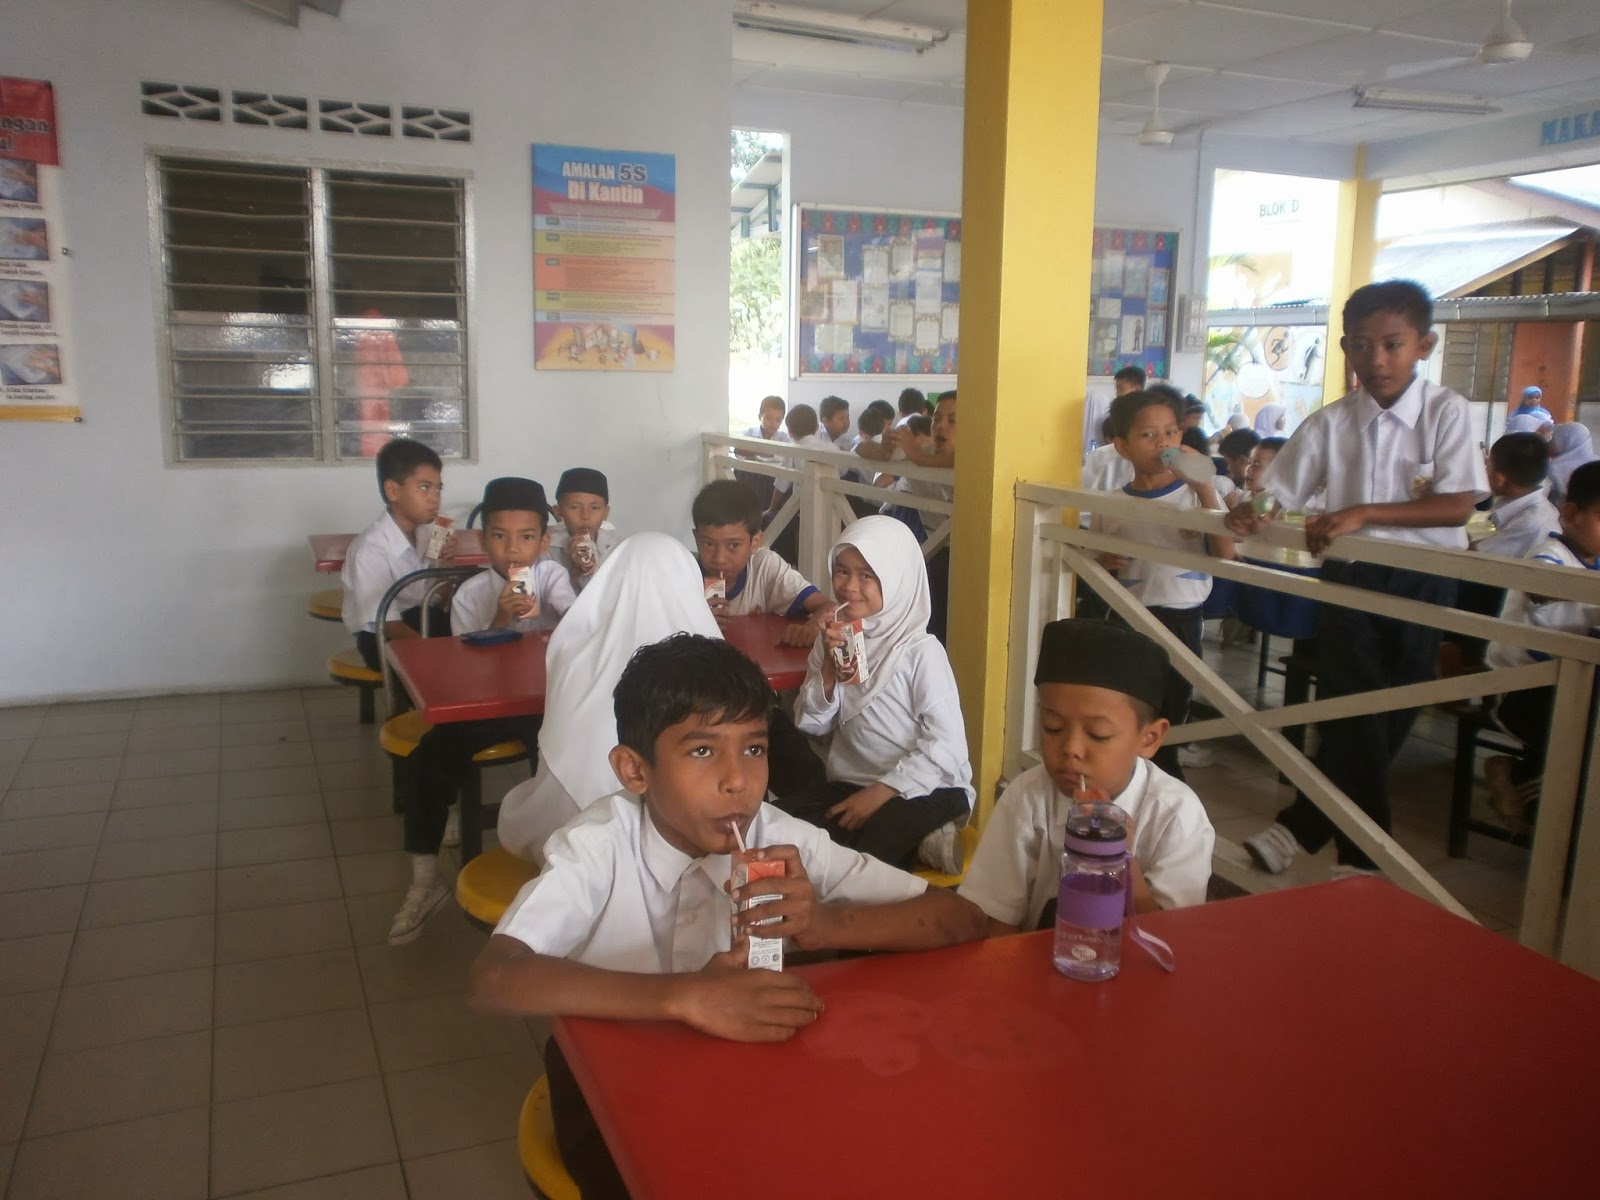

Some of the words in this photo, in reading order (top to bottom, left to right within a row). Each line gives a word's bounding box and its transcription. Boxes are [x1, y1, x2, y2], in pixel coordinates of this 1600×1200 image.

[562, 161, 615, 180] AMALAN
[618, 163, 648, 183] 5S
[588, 181, 644, 204] Kantin
[1260, 200, 1286, 217] BLOK
[1291, 199, 1300, 213] D
